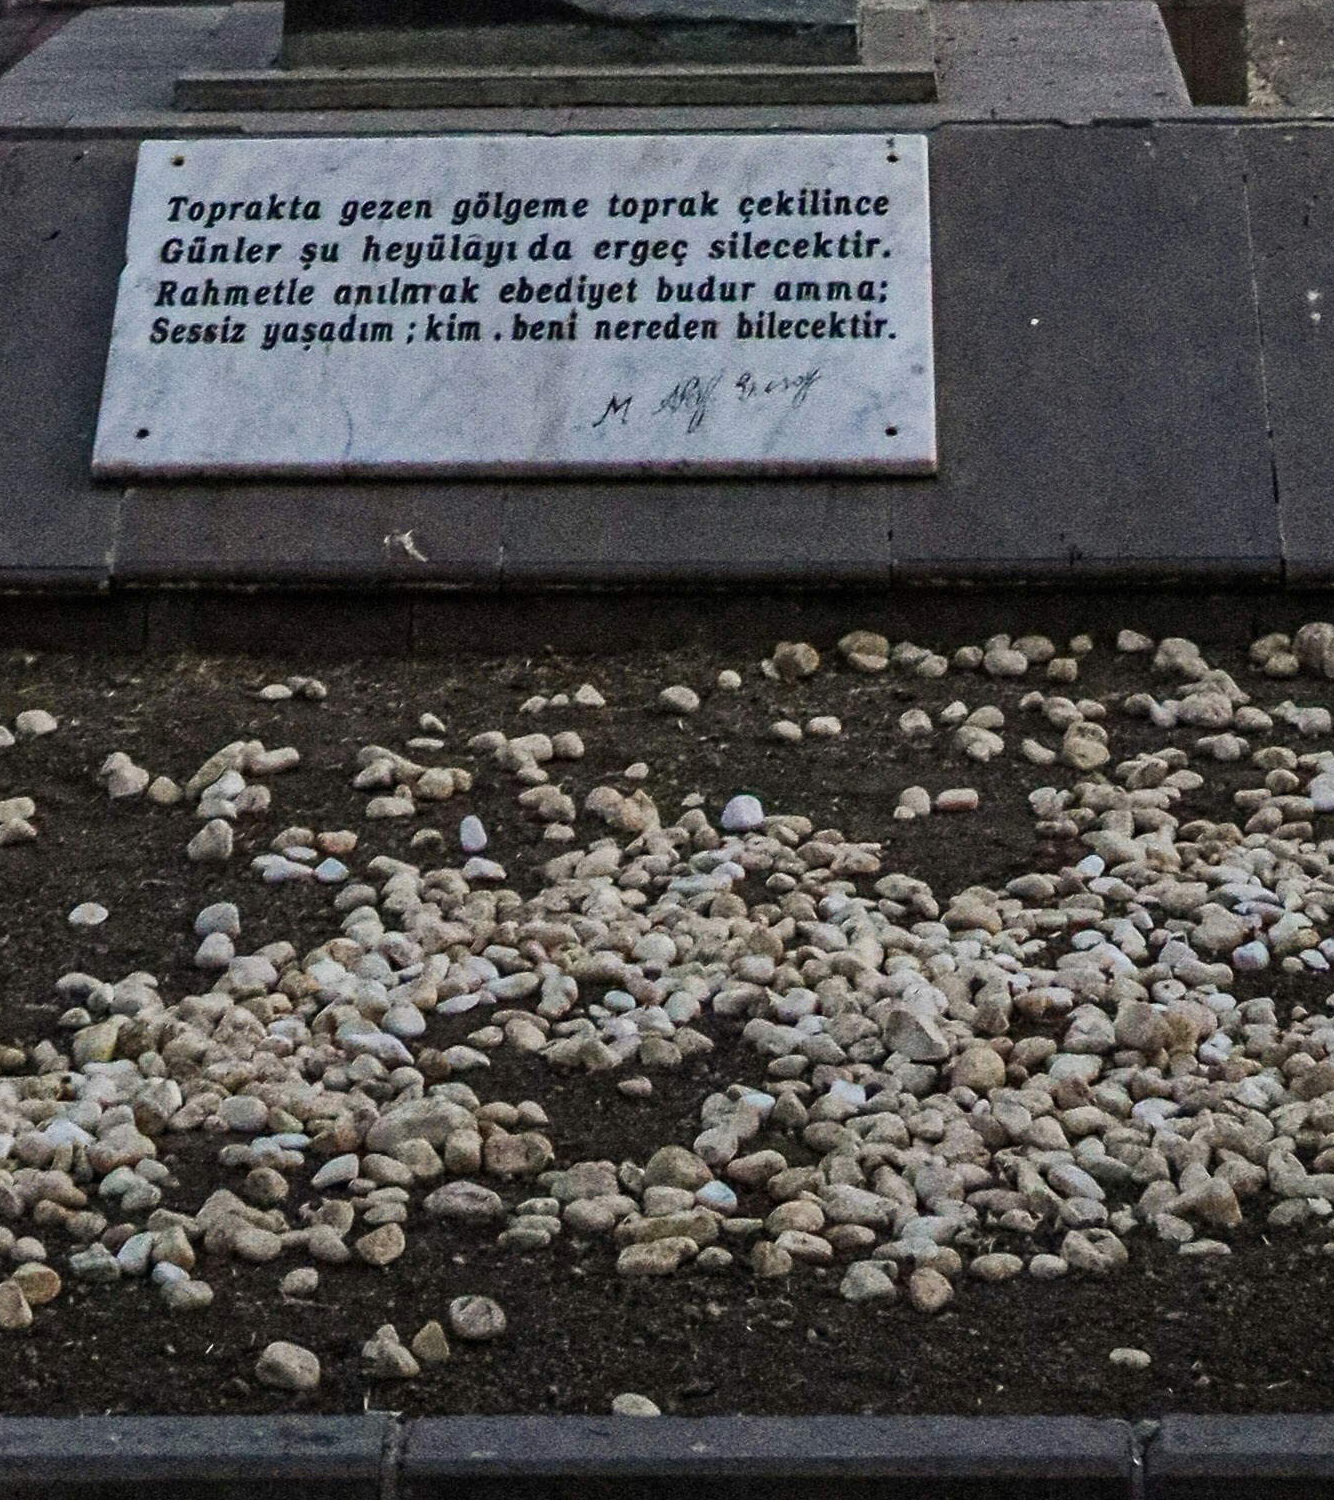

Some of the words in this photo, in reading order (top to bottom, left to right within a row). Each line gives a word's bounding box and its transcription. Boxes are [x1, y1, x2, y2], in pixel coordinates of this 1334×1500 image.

[167, 193, 322, 229] Toprakta
[338, 198, 433, 227] gezen
[450, 190, 591, 226] gölgeme
[608, 190, 720, 224] toprak
[737, 187, 890, 224] çekilince
[159, 235, 283, 265] Günler
[299, 242, 340, 271] şu
[527, 232, 573, 262] da
[593, 239, 689, 268] ergeç
[707, 230, 892, 260] silecektir.
[153, 277, 315, 307] Rahmetle
[498, 274, 638, 311] ebediyet
[656, 275, 756, 304] budur
[773, 280, 889, 304] amma;
[149, 315, 247, 346] Sessiz
[511, 309, 578, 342] beni
[594, 312, 719, 341] nereden
[736, 309, 897, 341] bilecektir.
